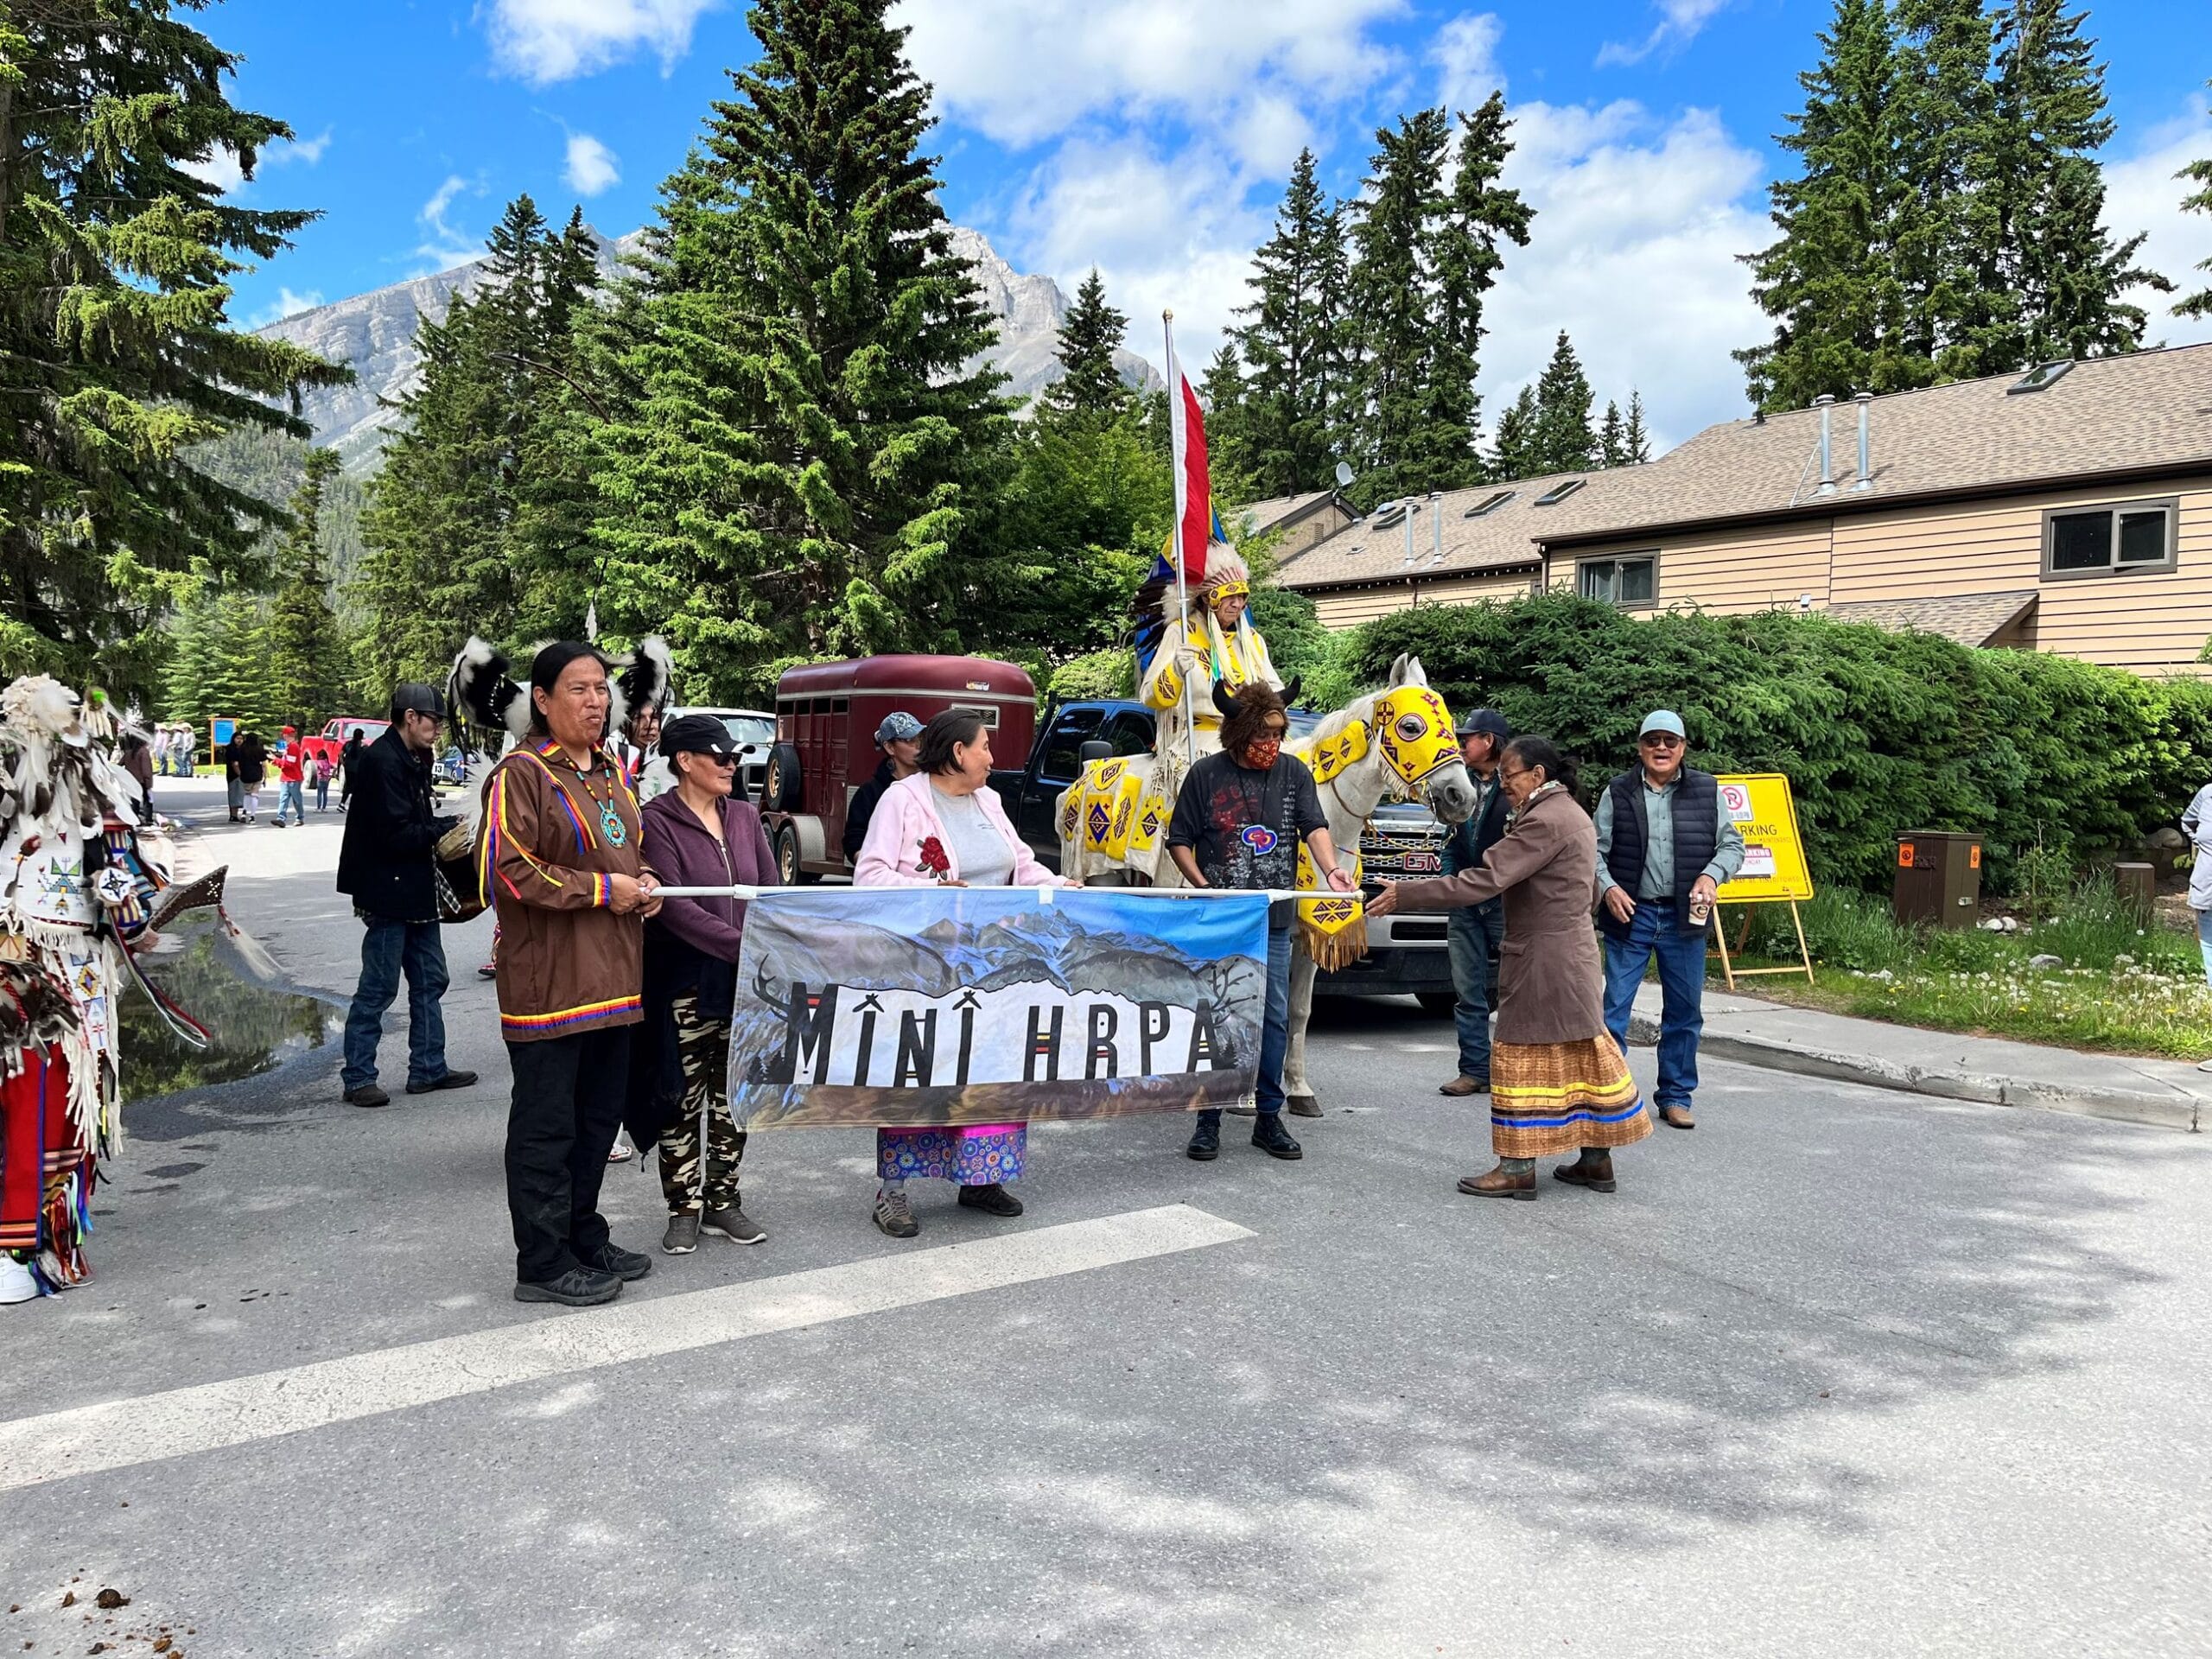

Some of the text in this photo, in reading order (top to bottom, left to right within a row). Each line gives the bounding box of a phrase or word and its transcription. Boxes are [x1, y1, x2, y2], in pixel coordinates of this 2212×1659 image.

[1734, 824, 1777, 836] RKING
[1404, 853, 1441, 871] GM
[1023, 998, 1215, 1081] HRPA
